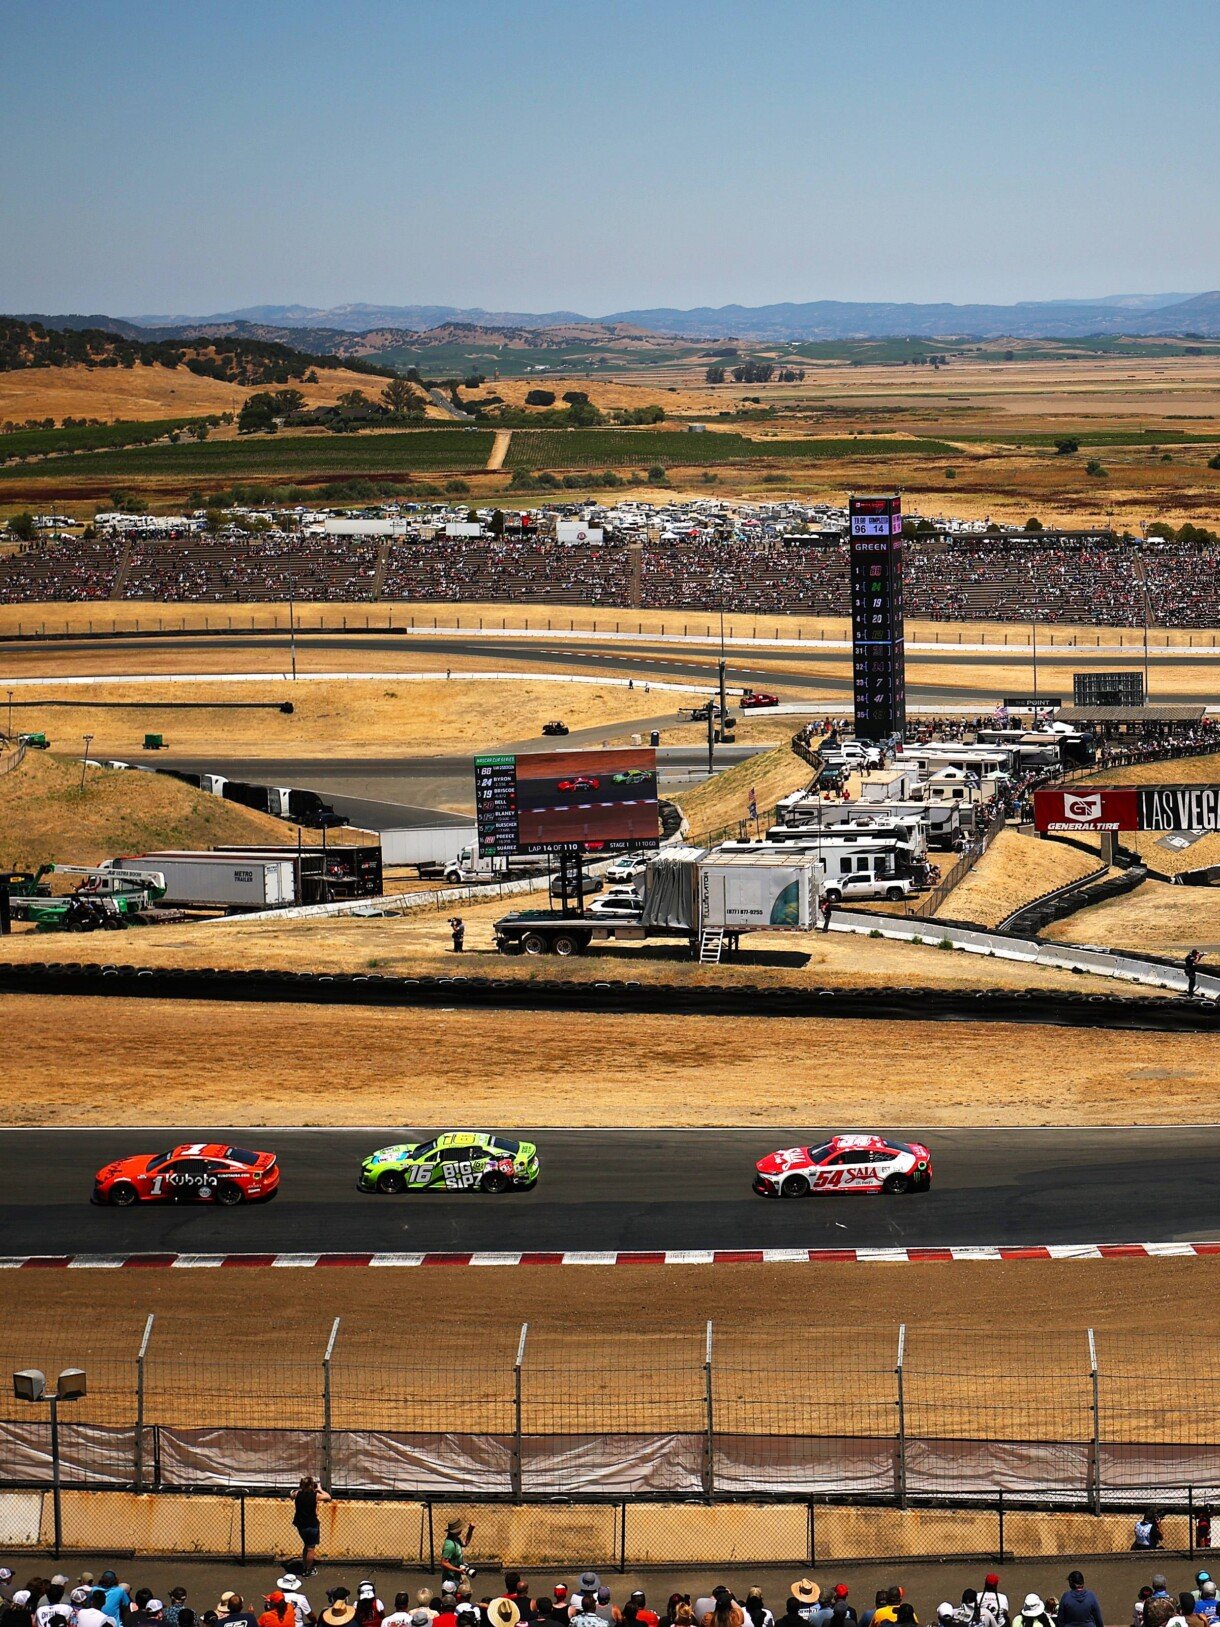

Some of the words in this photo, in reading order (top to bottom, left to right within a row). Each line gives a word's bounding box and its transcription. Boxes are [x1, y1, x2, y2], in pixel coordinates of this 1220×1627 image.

[855, 525, 866, 533] 96
[873, 525, 884, 533] 14
[855, 543, 887, 551] GREEN
[871, 582, 882, 591] 24
[872, 598, 882, 608] 19
[872, 614, 882, 623] 20
[855, 647, 863, 655] 31
[876, 678, 883, 687] 7
[874, 694, 884, 703] 41
[481, 778, 493, 787] 24
[483, 789, 493, 799] 19
[1069, 800, 1097, 816] GT
[1142, 791, 1174, 831] LAS
[1047, 822, 1095, 830] GENERAL
[1096, 822, 1120, 830] TIRE
[528, 845, 541, 853] LAP
[564, 843, 578, 851] 110
[180, 1143, 208, 1155] 1
[408, 1164, 434, 1183] 16
[844, 1166, 884, 1184] SAIA
[165, 1173, 218, 1186] Kubota
[813, 1170, 844, 1188] 54
[150, 1176, 163, 1195] 1
